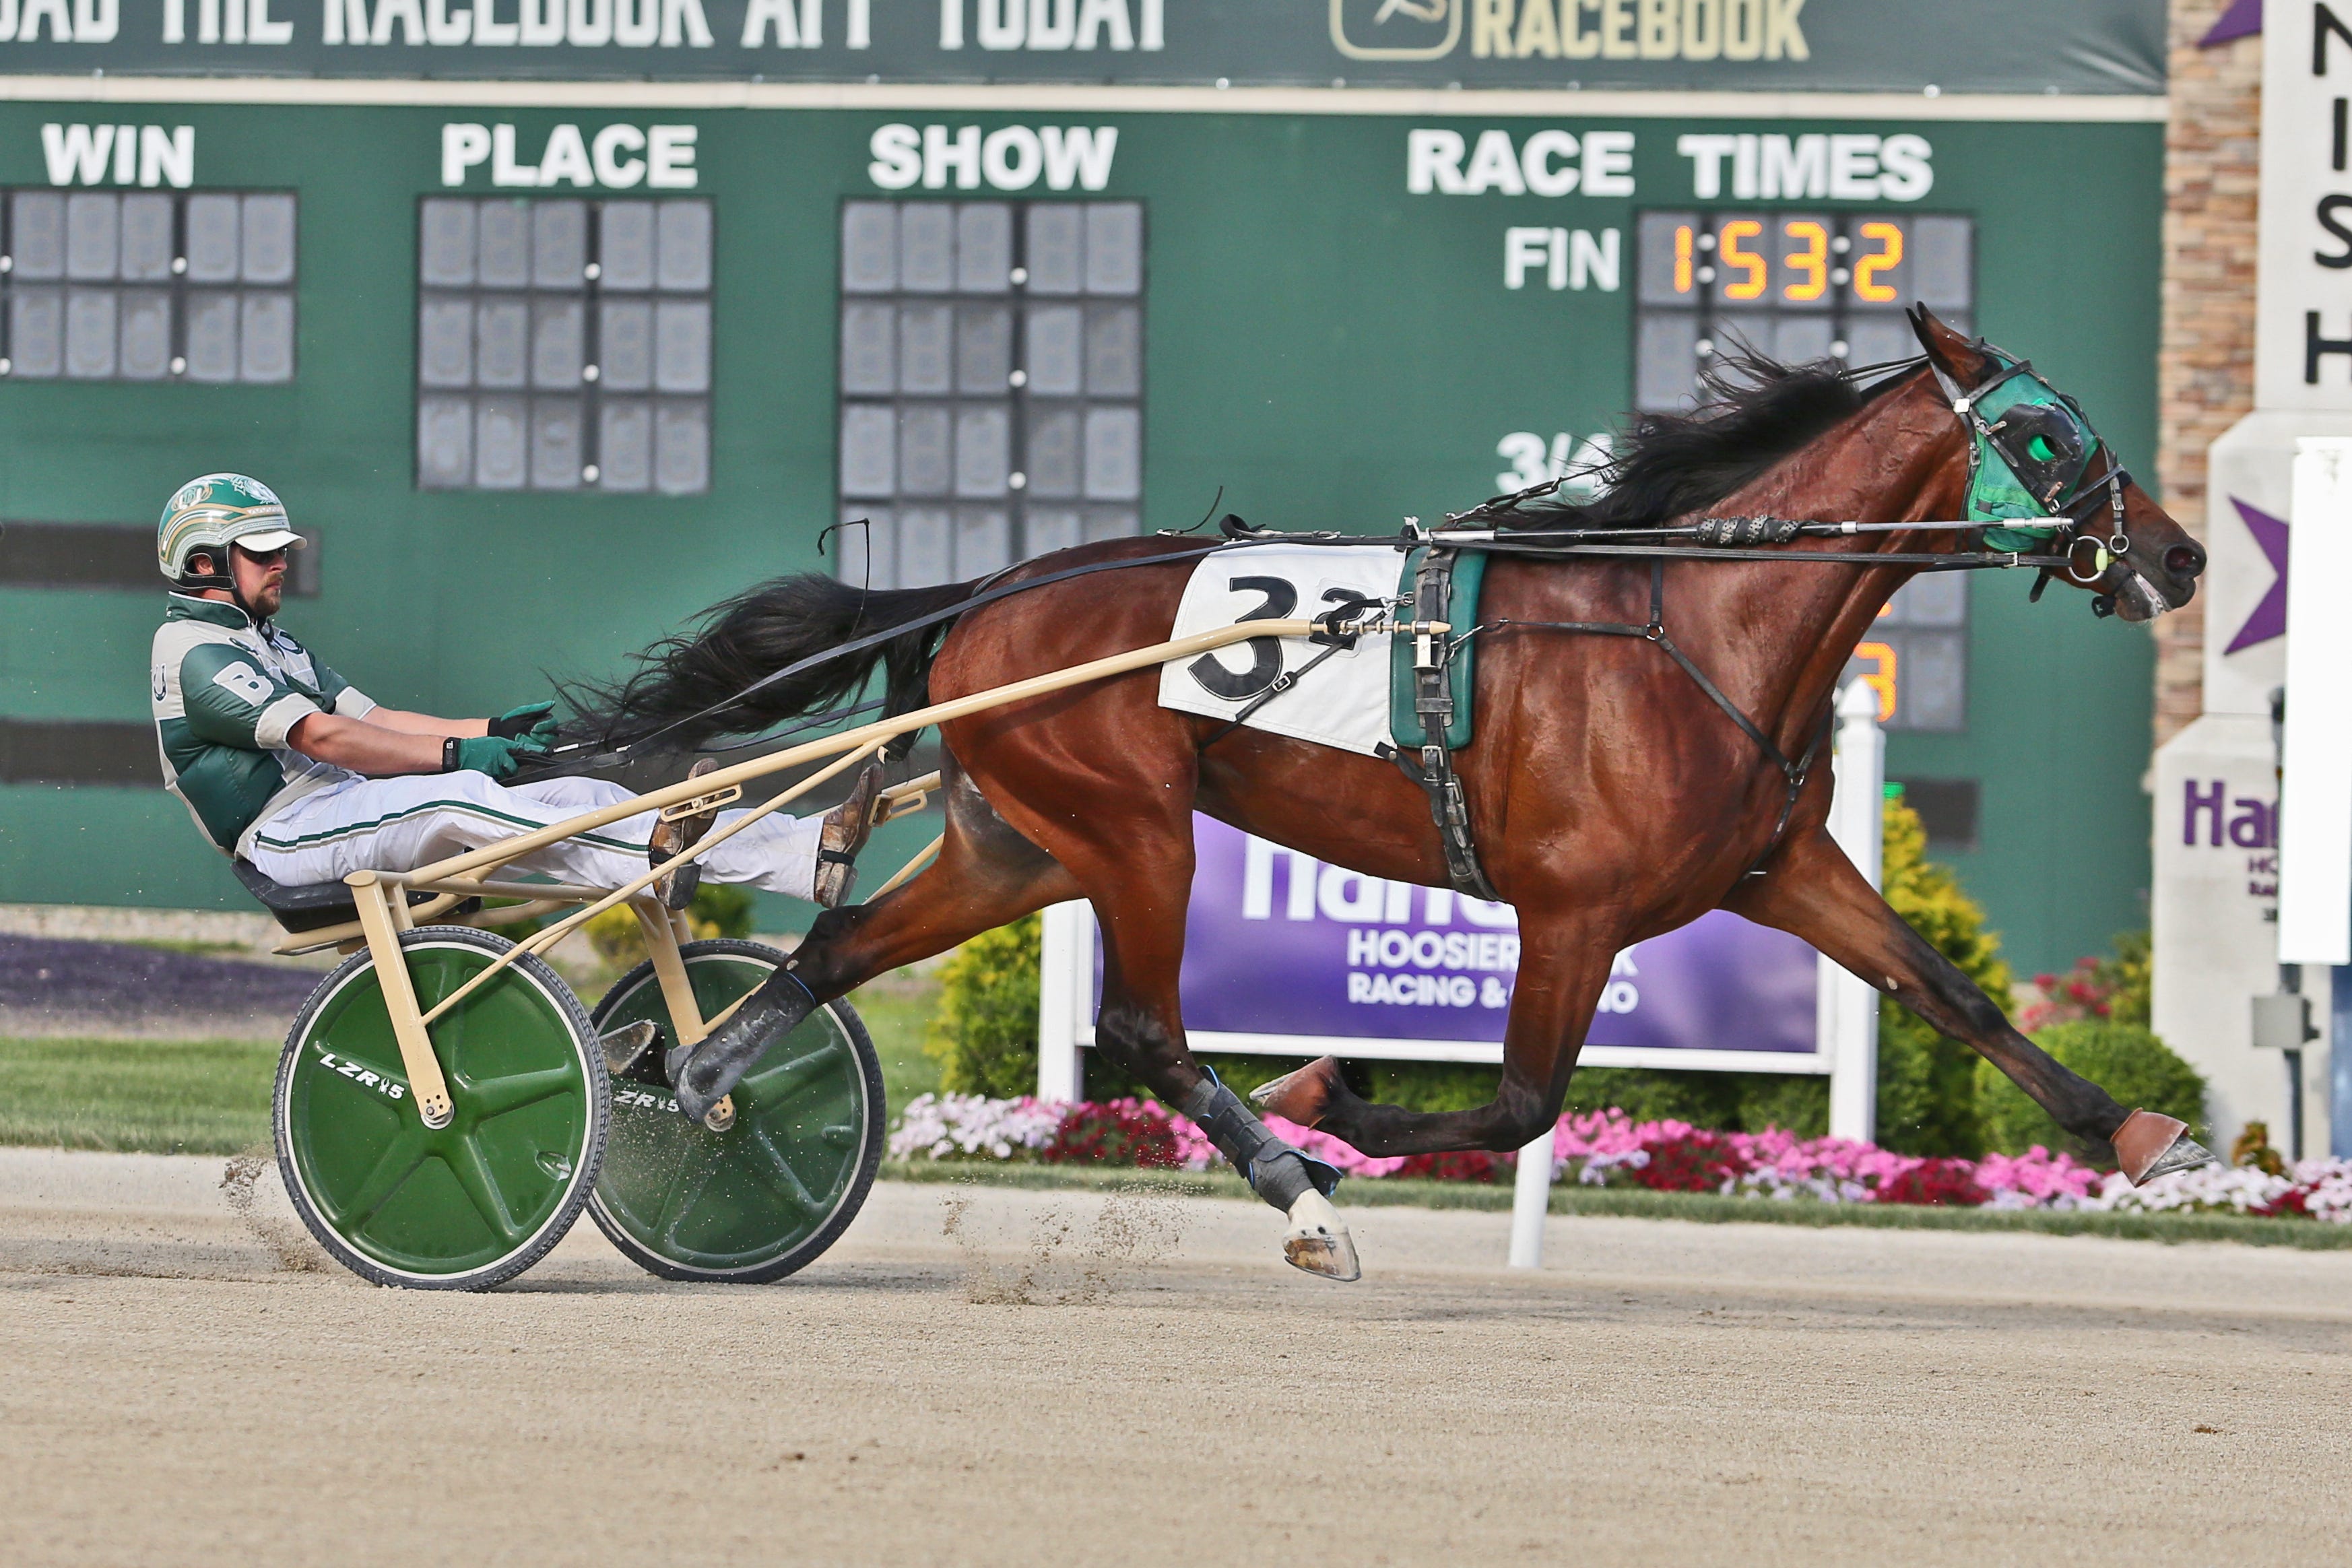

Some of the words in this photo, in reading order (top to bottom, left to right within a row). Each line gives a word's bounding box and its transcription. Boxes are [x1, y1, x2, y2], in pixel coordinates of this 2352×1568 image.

[1471, 0, 1810, 61] RACEBOOK
[40, 123, 195, 188] WIN
[441, 123, 698, 189] PLACE
[868, 123, 1119, 191] SHOW
[1406, 128, 1635, 197] RACE
[1676, 133, 1934, 202] TIMES
[1504, 226, 1621, 292] FIN
[1187, 575, 1299, 702] 3
[211, 660, 275, 707] B
[1348, 927, 1521, 973] HOOSIER
[1348, 972, 1478, 1008] RACING
[1480, 975, 1508, 1009] &
[319, 1052, 381, 1088] LZR
[613, 1090, 657, 1109] ZR
